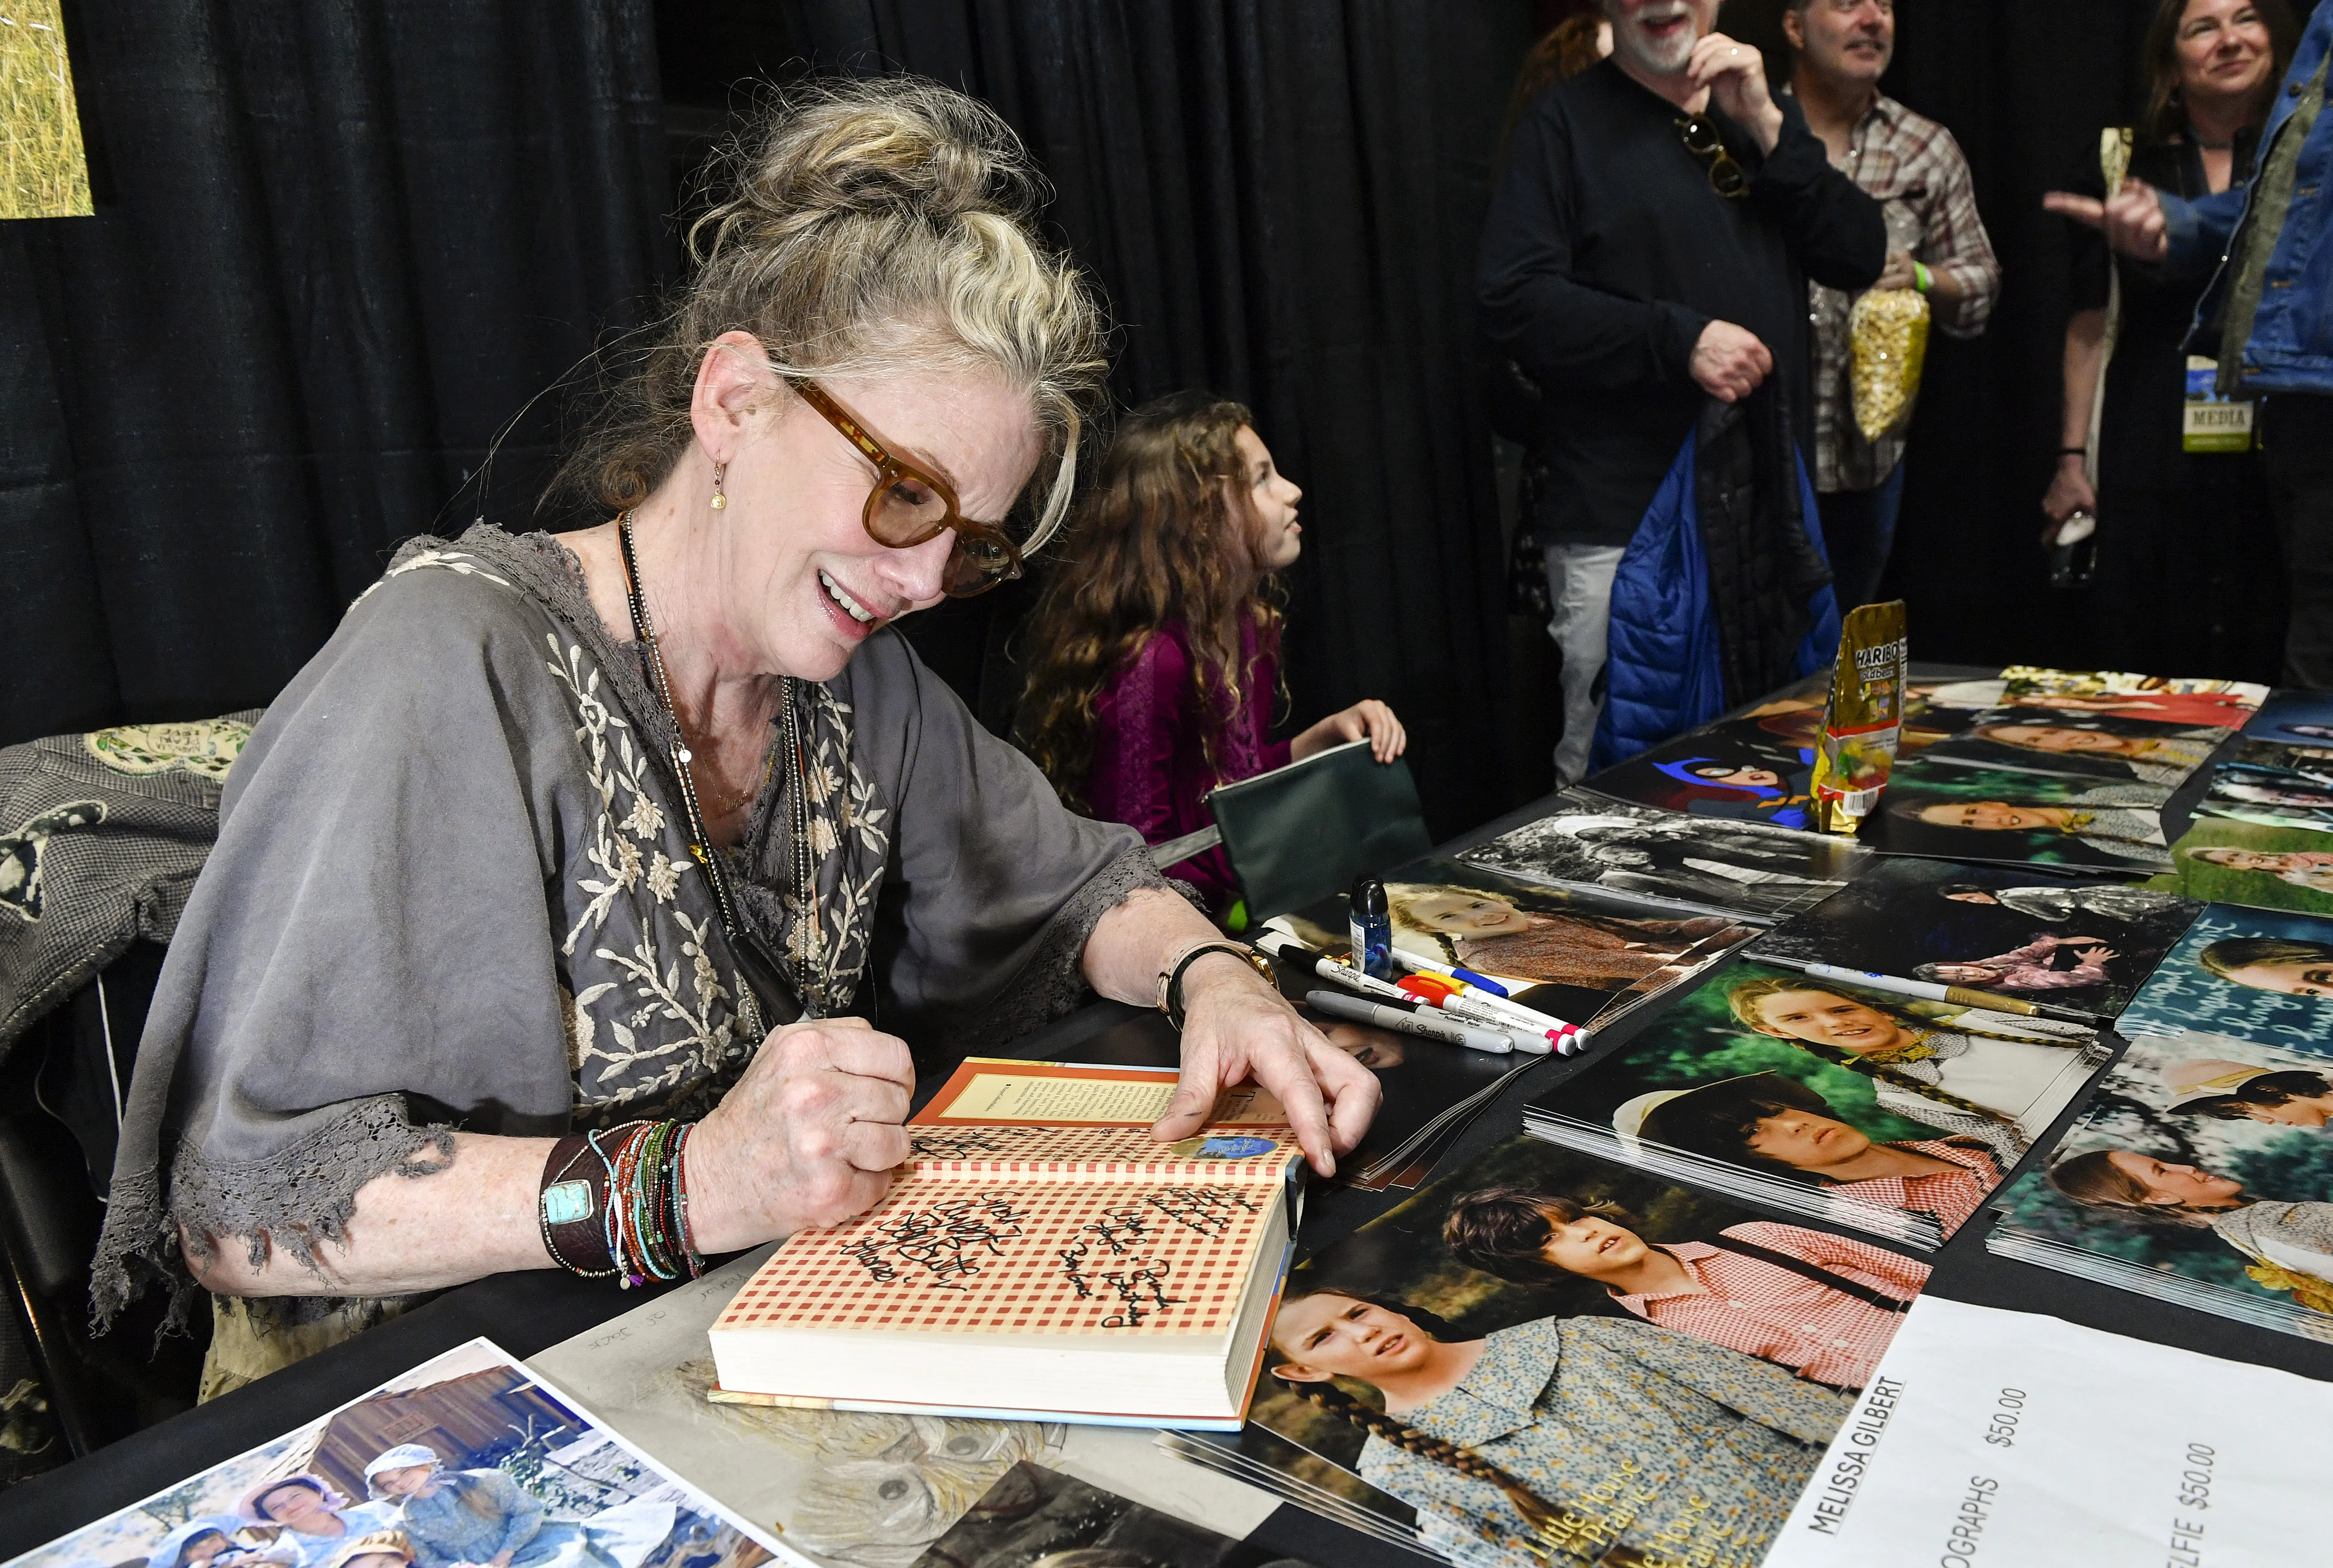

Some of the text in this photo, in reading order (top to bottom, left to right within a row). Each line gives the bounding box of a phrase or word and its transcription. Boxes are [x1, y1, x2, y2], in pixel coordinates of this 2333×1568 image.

[2194, 410, 2245, 425] MEDIA
[1856, 642, 1899, 668] HARIBO
[1416, 1024, 1448, 1040] Sharpie
[587, 1326, 634, 1351] Jack
[1983, 1387, 2027, 1448] $50.00
[1808, 1375, 1903, 1535] MELISSA GILBERT
[2179, 1443, 2216, 1510] $50.00
[1528, 1459, 1643, 1560] Little House
[1579, 1485, 1658, 1546] Prairie
[1646, 1494, 1712, 1556] House
